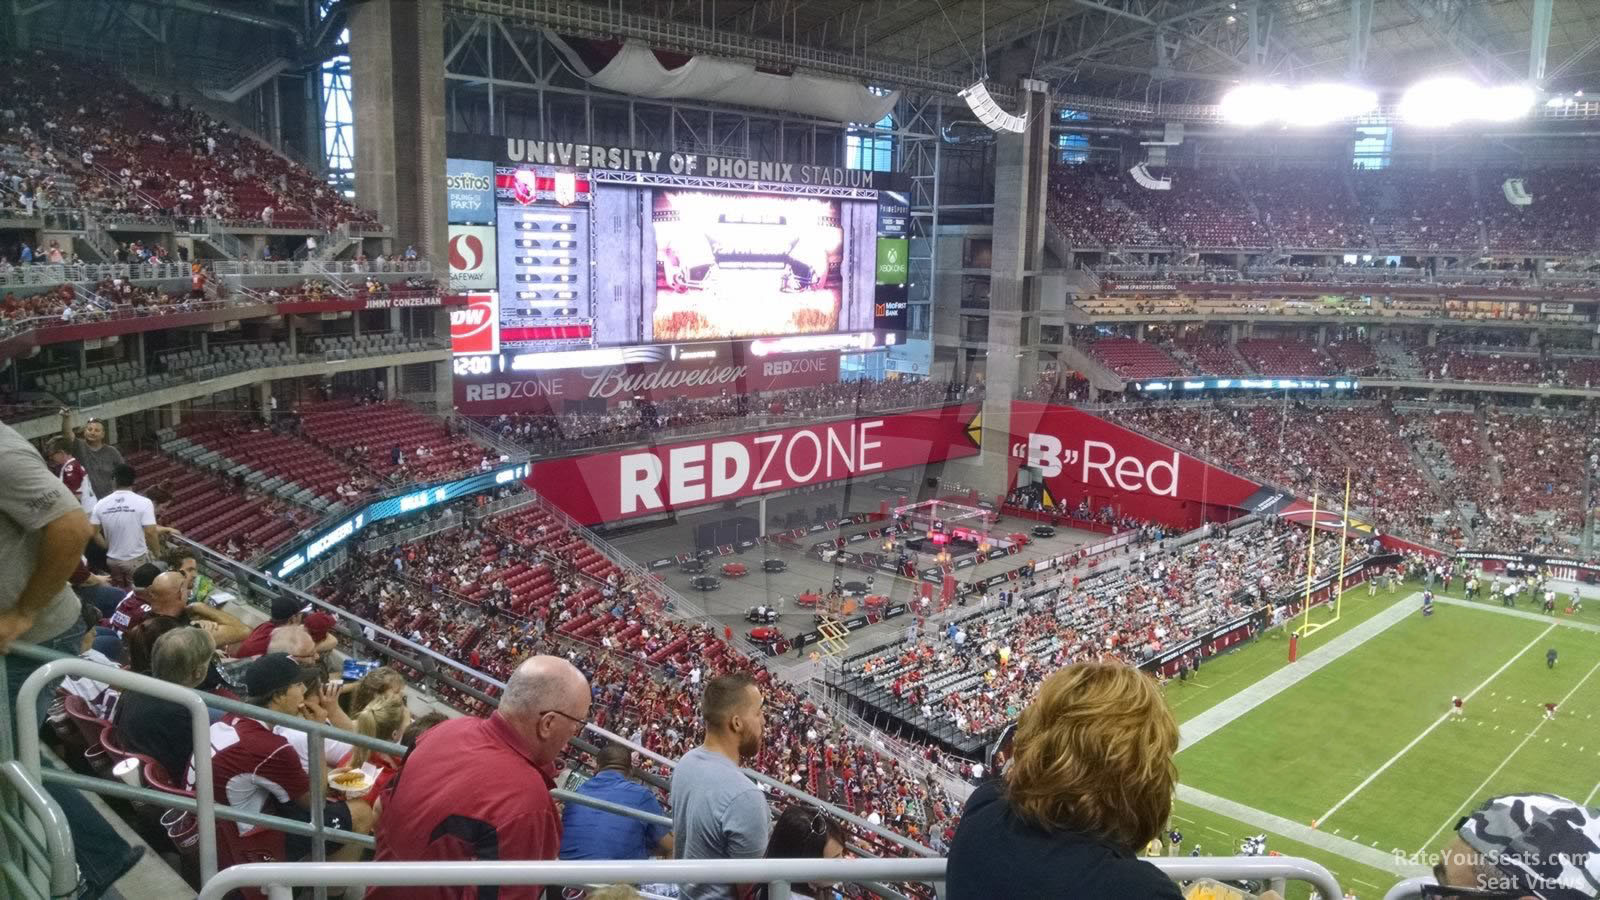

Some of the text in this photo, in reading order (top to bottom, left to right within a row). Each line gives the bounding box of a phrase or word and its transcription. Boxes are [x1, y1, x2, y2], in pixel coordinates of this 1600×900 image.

[507, 138, 873, 188] UNIVERSITY OF PHOENIX STADIUM
[450, 201, 481, 210] PARTY
[449, 273, 483, 281] SAFEWAY
[365, 298, 441, 309] JIMMY CONZELMAN
[451, 308, 485, 325] DW
[763, 357, 827, 377] REDZONE
[466, 378, 563, 402] REDZONE
[582, 364, 748, 398] Budweiser
[620, 420, 884, 514] REDZONE
